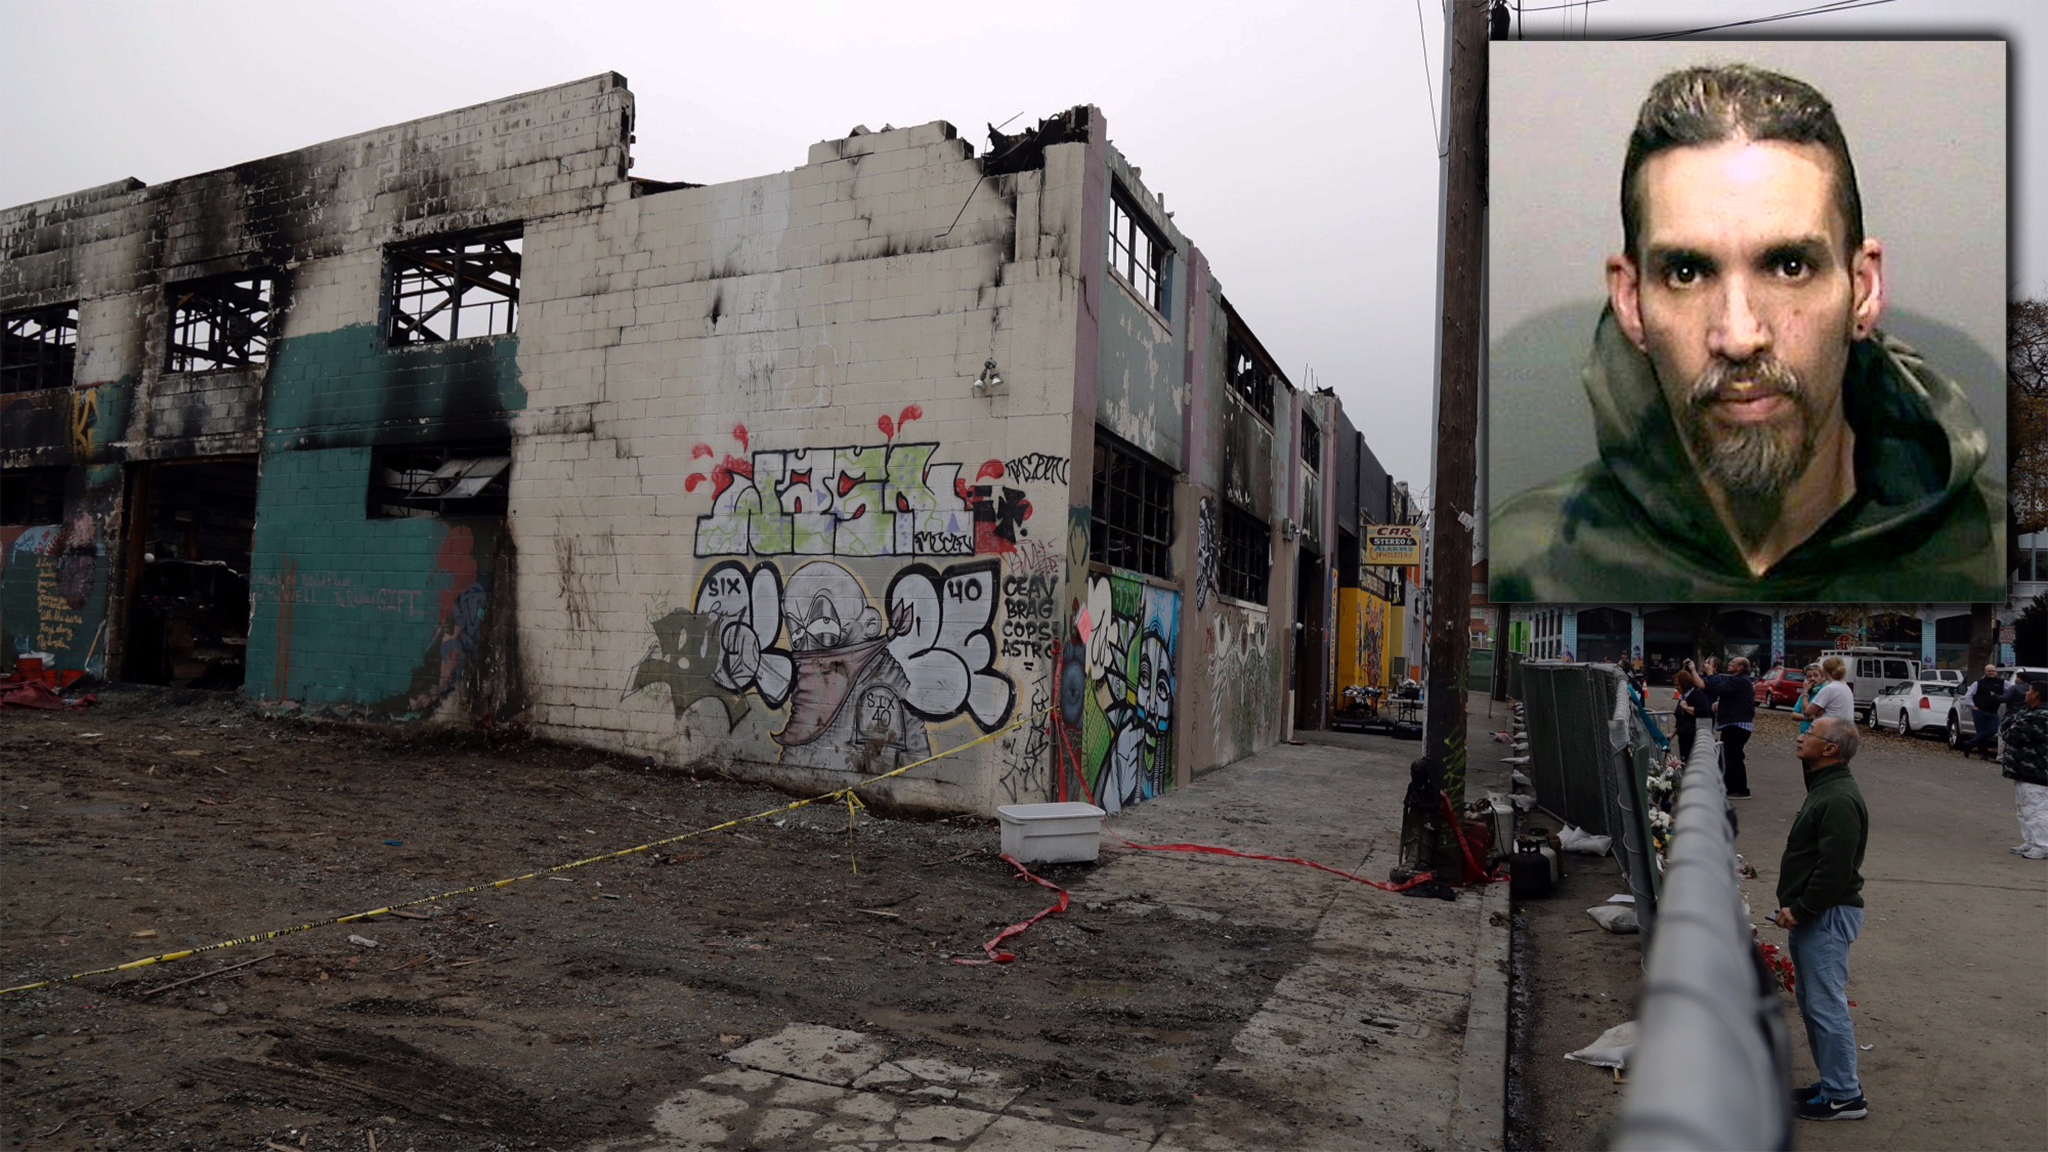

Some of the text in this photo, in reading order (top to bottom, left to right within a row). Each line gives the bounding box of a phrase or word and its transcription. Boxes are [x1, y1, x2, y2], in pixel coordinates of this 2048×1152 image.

[1376, 527, 1412, 538] CAR
[708, 577, 741, 597] SIX
[947, 578, 982, 604] 40
[1004, 597, 1054, 619] BRAG
[1002, 620, 1052, 641] COPS
[866, 692, 896, 710] SIX
[871, 707, 892, 728] 40
